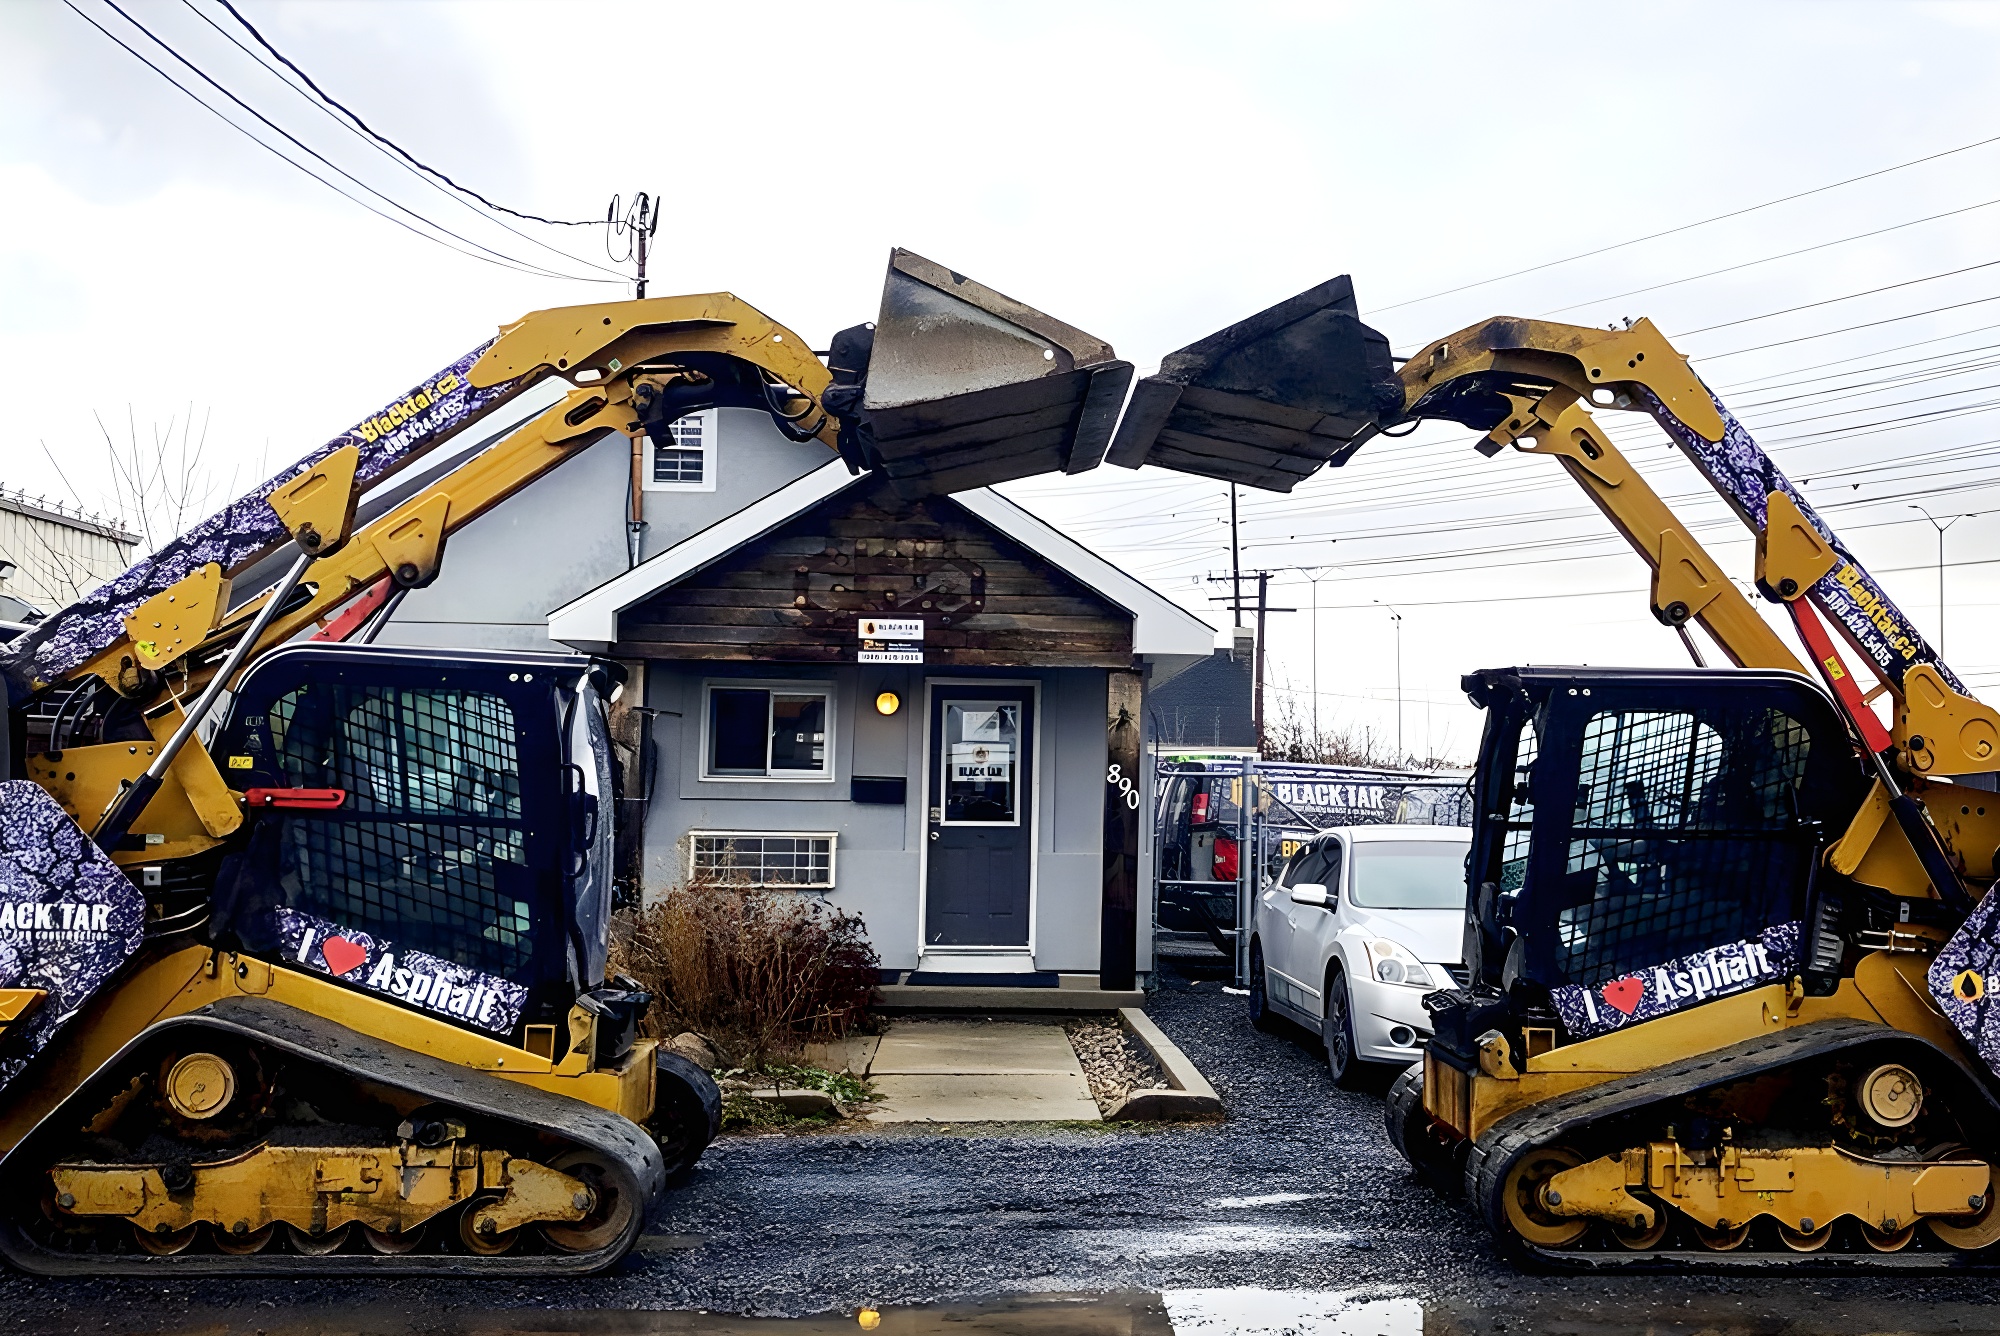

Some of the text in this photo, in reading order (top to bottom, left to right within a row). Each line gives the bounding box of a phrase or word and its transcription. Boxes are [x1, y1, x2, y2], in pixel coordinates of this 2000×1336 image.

[360, 372, 459, 443] Blacktar.ca
[1107, 763, 1140, 810] 890
[1277, 783, 1385, 809] BLACK TAR
[60, 903, 110, 932] TAR
[297, 927, 500, 1024] I Asphalt
[1583, 943, 1774, 1024] I Asphalt
